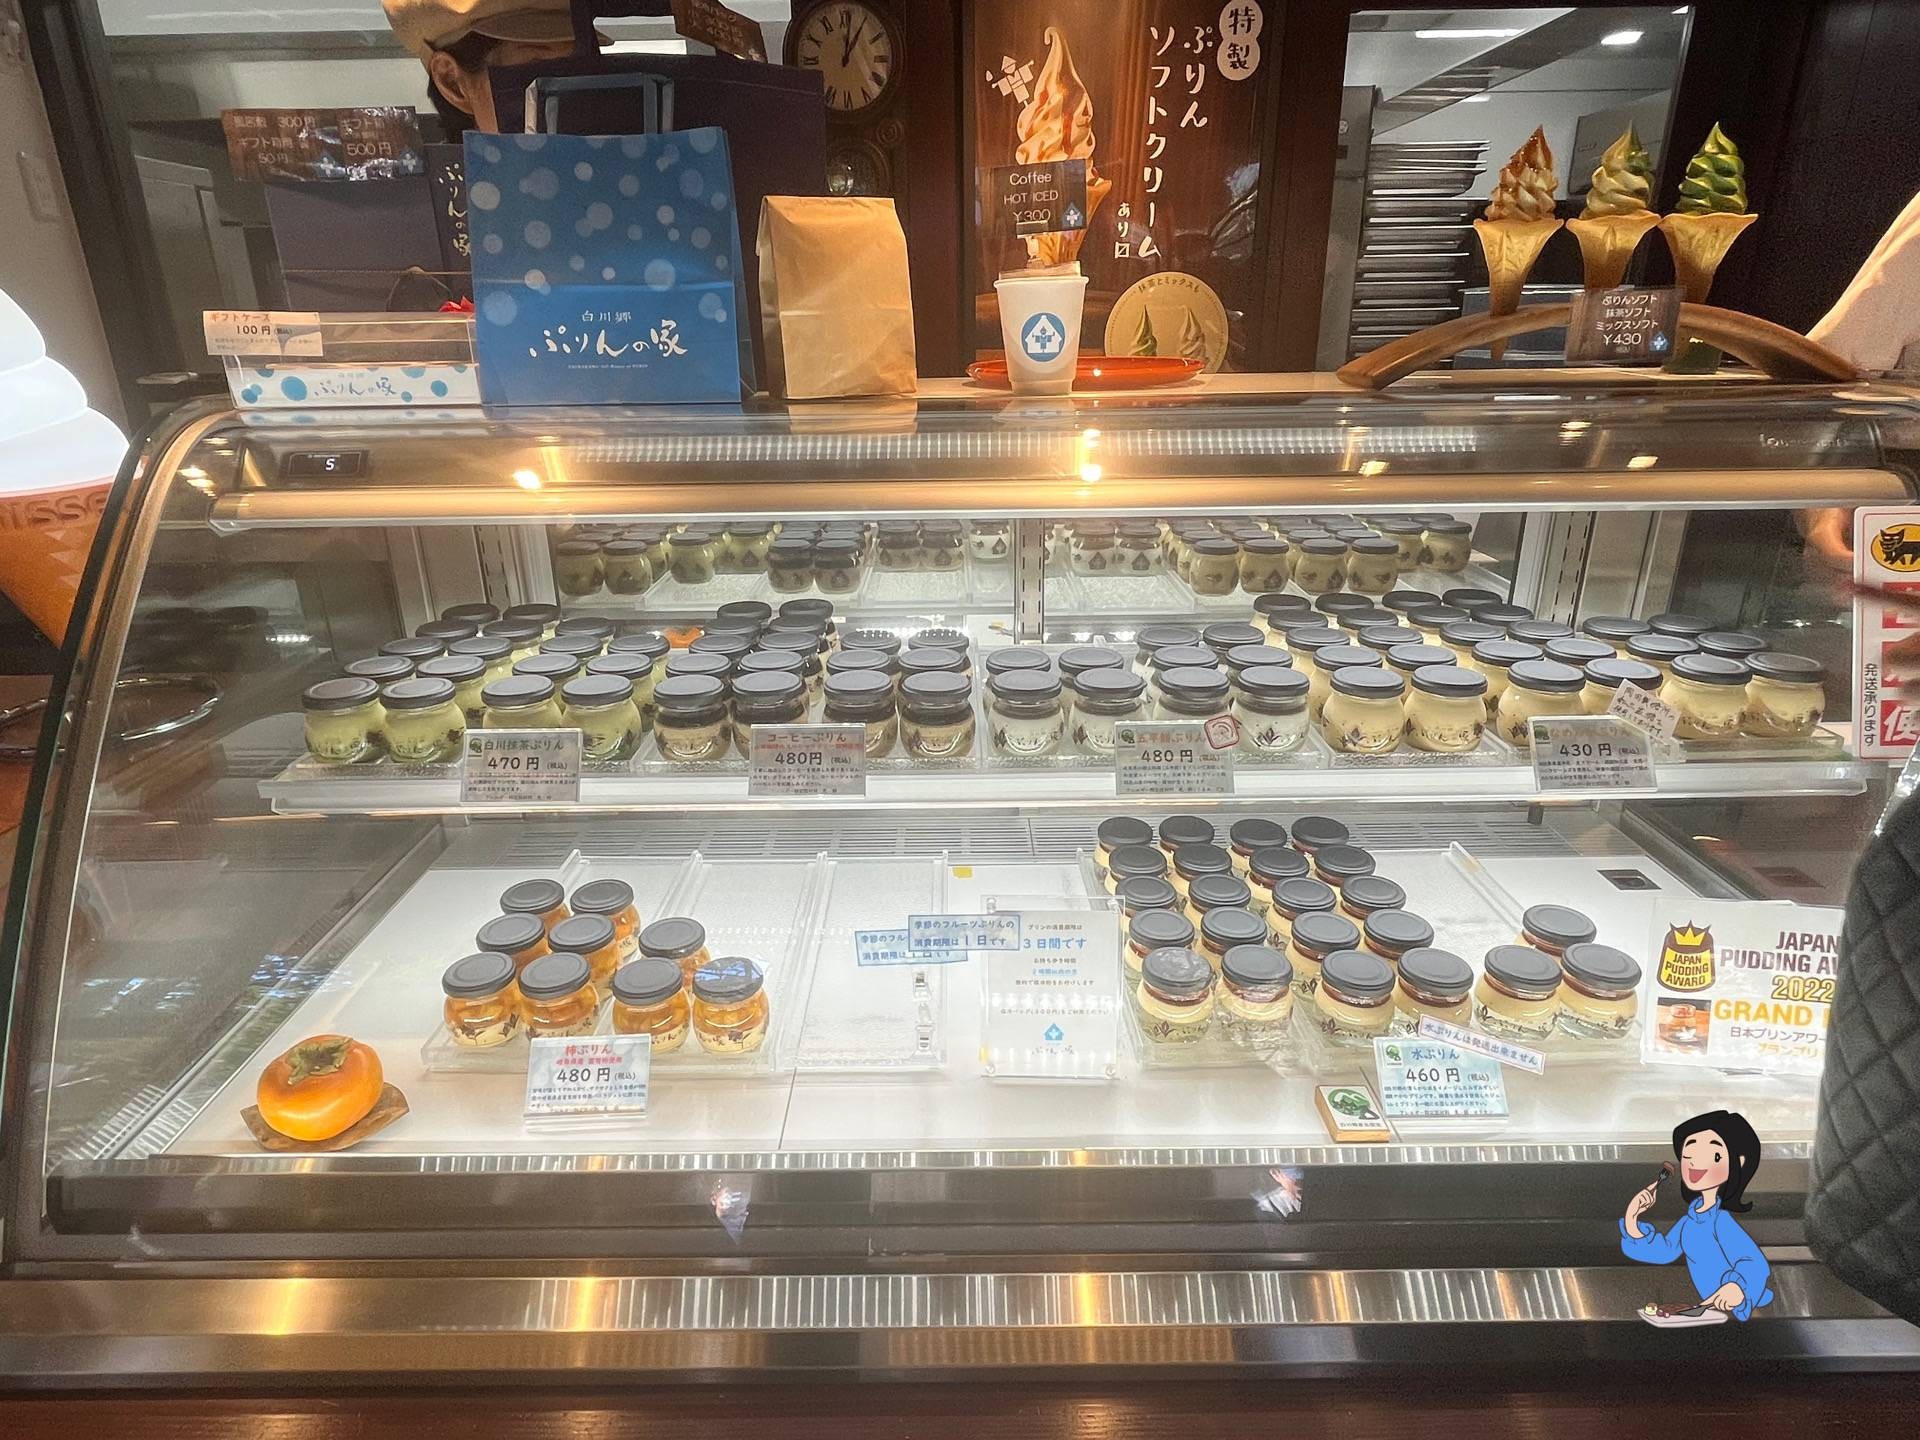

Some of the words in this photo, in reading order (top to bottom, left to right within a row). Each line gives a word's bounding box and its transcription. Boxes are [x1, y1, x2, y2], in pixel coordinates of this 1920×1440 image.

[1227, 6, 1256, 70] 特製
[1180, 26, 1213, 128] ぷりん
[1138, 26, 1175, 258] ソフトクリーム
[347, 143, 392, 156] 500円
[258, 153, 289, 164] 50円
[1009, 171, 1052, 186] Coffee
[1003, 192, 1028, 205] HOT
[1032, 190, 1059, 202] ICED
[1602, 294, 1658, 306] ぷりんソフト
[582, 310, 632, 323] 白川郷
[1606, 307, 1652, 318] 抹茶ソフト
[236, 325, 271, 335] 100円
[1596, 319, 1659, 331] ミックスソフト
[529, 319, 689, 358] ぷりんの家
[1863, 662, 1878, 747] 発送承ります
[767, 733, 847, 743] コーヒーぷりん
[1141, 749, 1193, 763] 480円
[1560, 743, 1612, 757] 430円
[488, 757, 540, 770] 470円
[775, 752, 822, 765] 480円
[914, 920, 1015, 929] 季節のフルーツぷりんの
[1775, 931, 1840, 953] JAPAN
[1672, 953, 1702, 965] JAPAN
[1720, 948, 1811, 973] PUDDING
[1664, 960, 1709, 976] PUDDING
[1665, 973, 1706, 987] AWARD
[1770, 975, 1836, 1004] 2022
[1714, 999, 1813, 1027] GRAND
[565, 1043, 613, 1056] 柿ぷりん
[1411, 1048, 1460, 1060] 水ぷりん
[556, 1067, 610, 1082] 480円
[614, 1072, 636, 1081] (税込)
[1406, 1068, 1460, 1082] 460円
